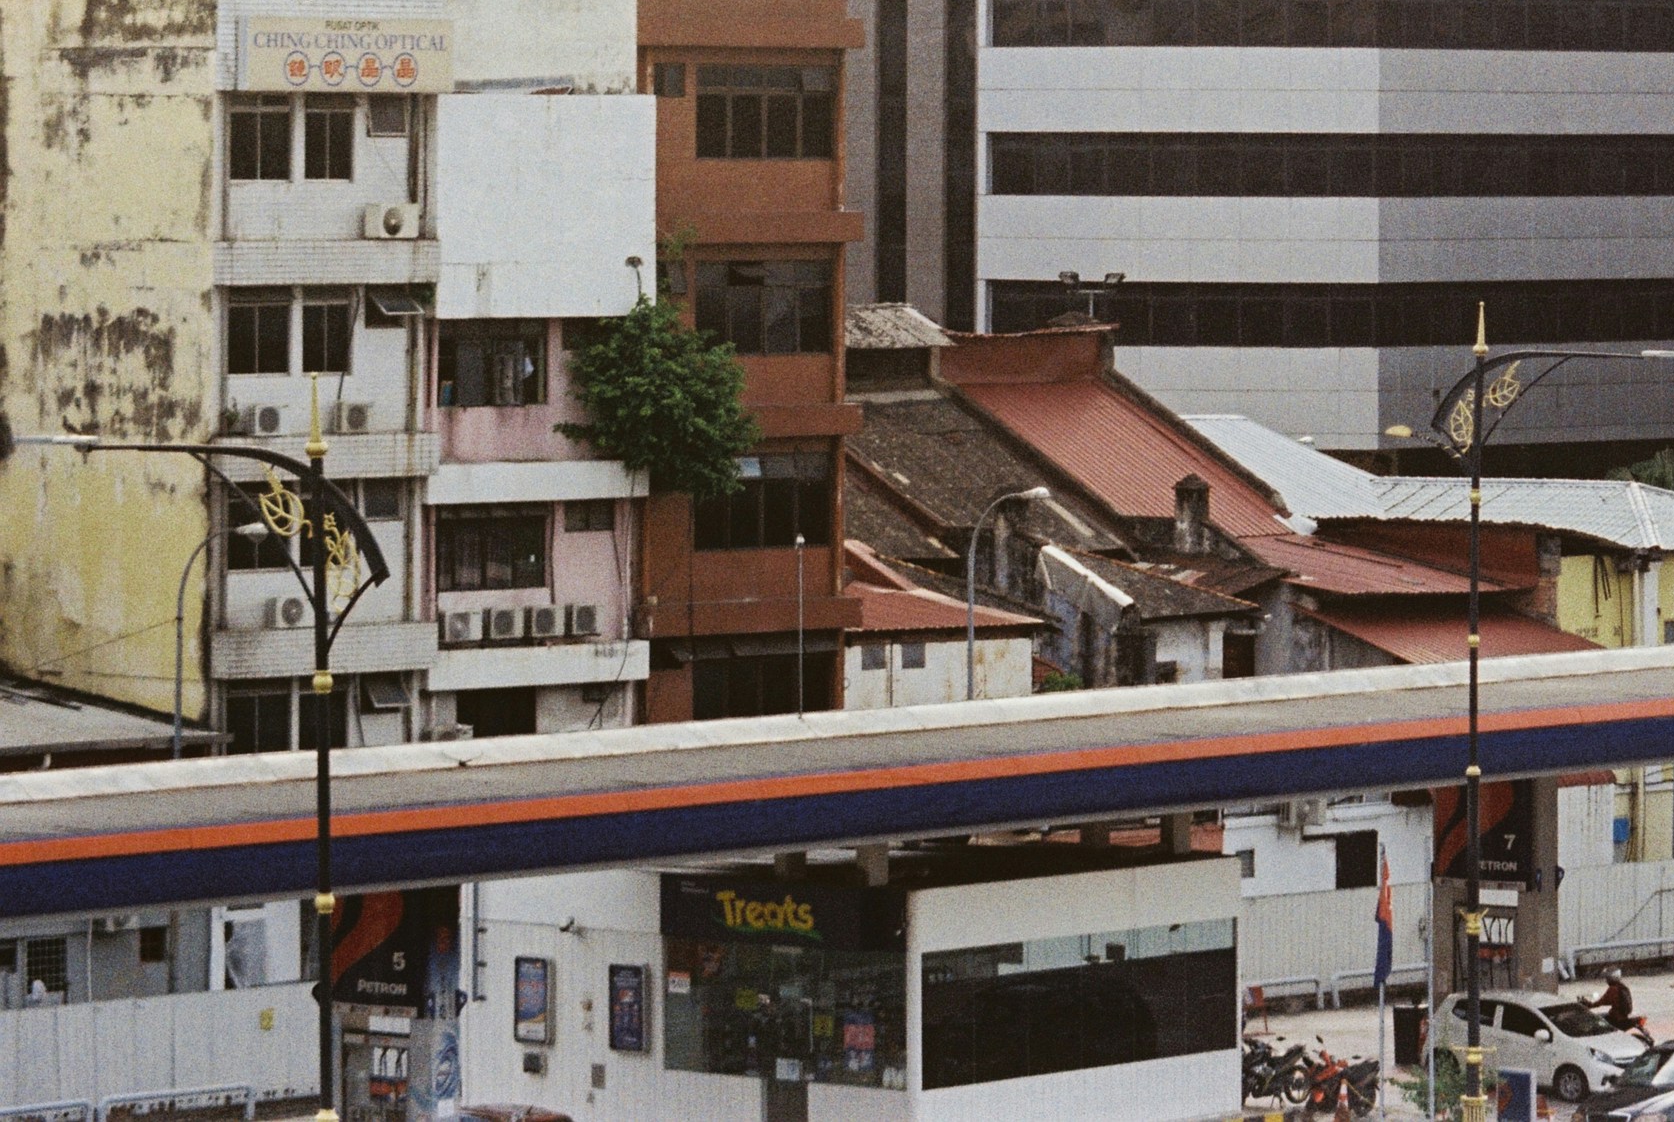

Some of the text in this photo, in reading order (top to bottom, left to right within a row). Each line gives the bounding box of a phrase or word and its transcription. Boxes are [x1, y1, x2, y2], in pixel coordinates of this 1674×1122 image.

[253, 31, 447, 52] CHING CHING OPTICAL
[1504, 834, 1516, 850] 7
[1480, 860, 1518, 872] ETRON
[715, 890, 815, 931] Treats
[392, 951, 406, 971] 5
[357, 979, 407, 996] PETRON
